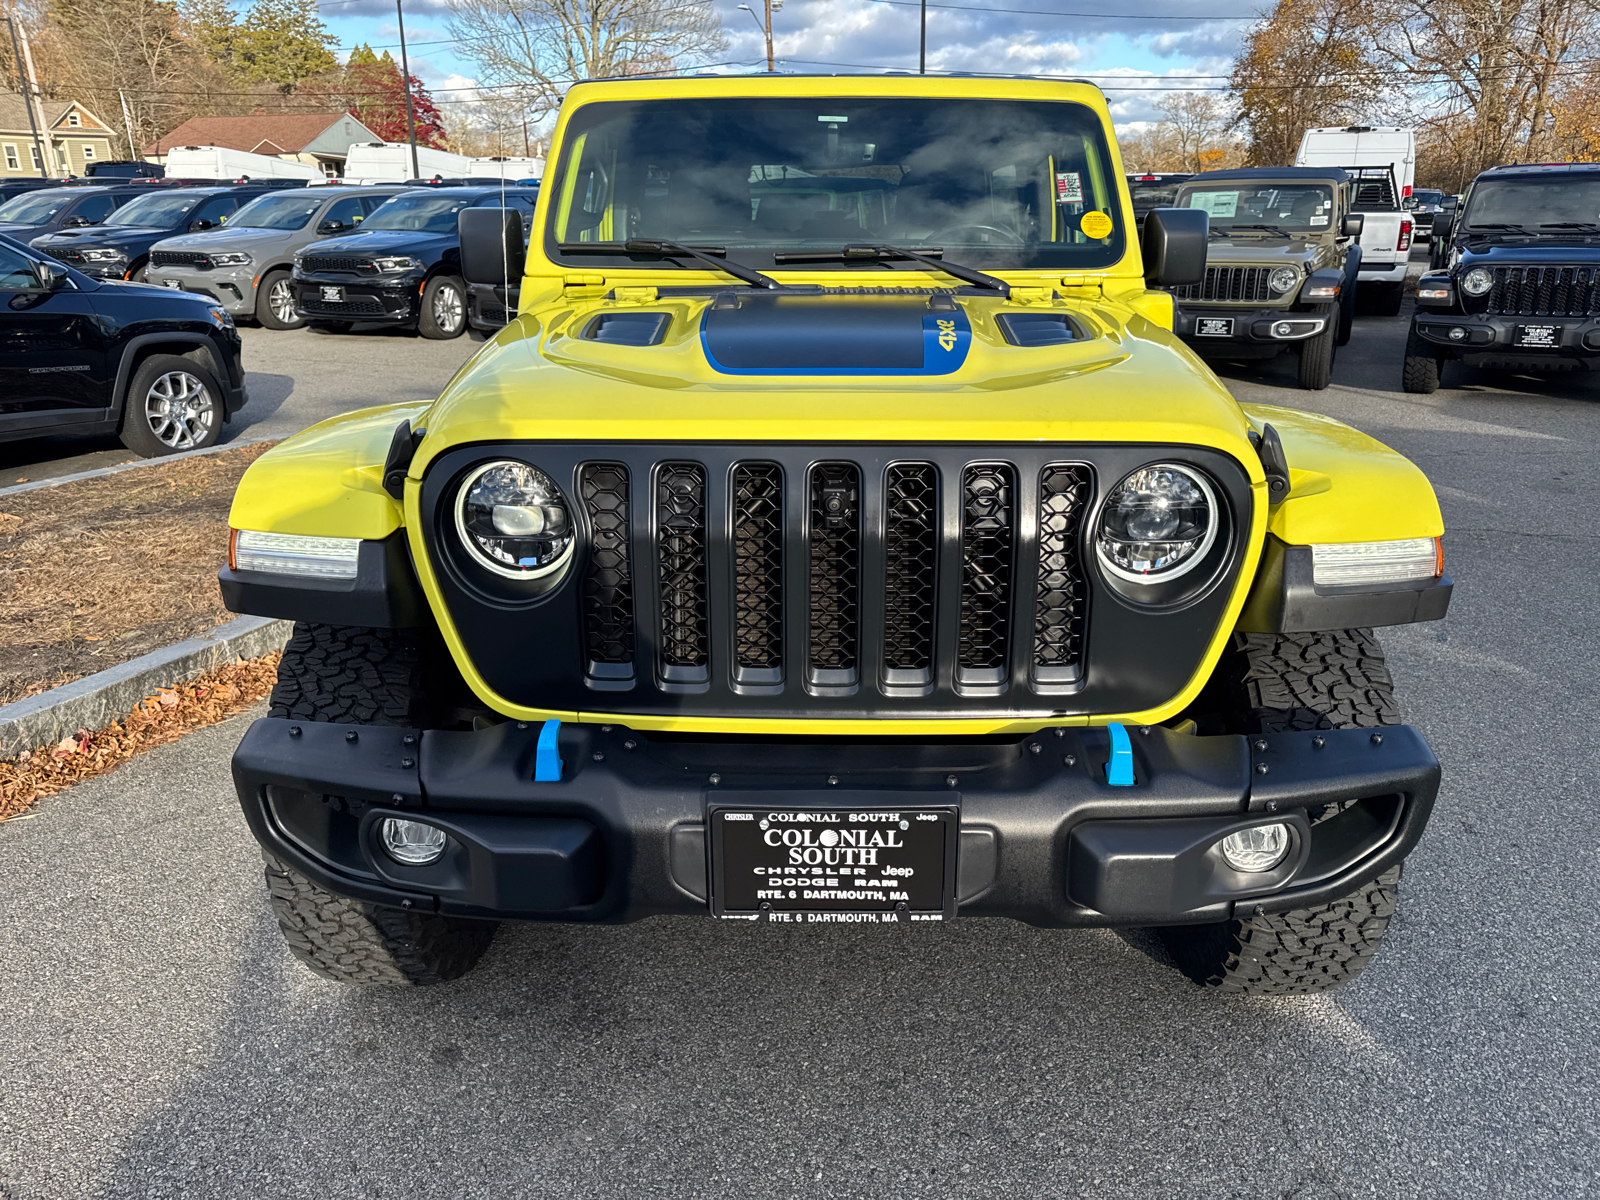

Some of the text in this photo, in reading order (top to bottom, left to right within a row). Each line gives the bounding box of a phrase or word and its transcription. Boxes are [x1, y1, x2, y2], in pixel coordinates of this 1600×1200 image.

[936, 319, 957, 352] 4xe
[724, 813, 754, 821] CHRYSLER
[767, 812, 900, 823] COLONIAL SOUTH
[916, 813, 939, 822] Jeep
[763, 828, 904, 848] COLONIAL
[788, 847, 879, 866] SOUTH
[753, 866, 867, 876] CHRYSLER
[881, 864, 914, 877] Jeep
[768, 878, 839, 887] DODGE
[854, 879, 899, 888] RAM
[757, 890, 910, 901] RTE. 6 DARTMOUTH, MA
[769, 913, 795, 923] RTE.
[795, 913, 803, 923] 6
[807, 913, 880, 924] DARTMOUTH,
[881, 914, 899, 923] MA
